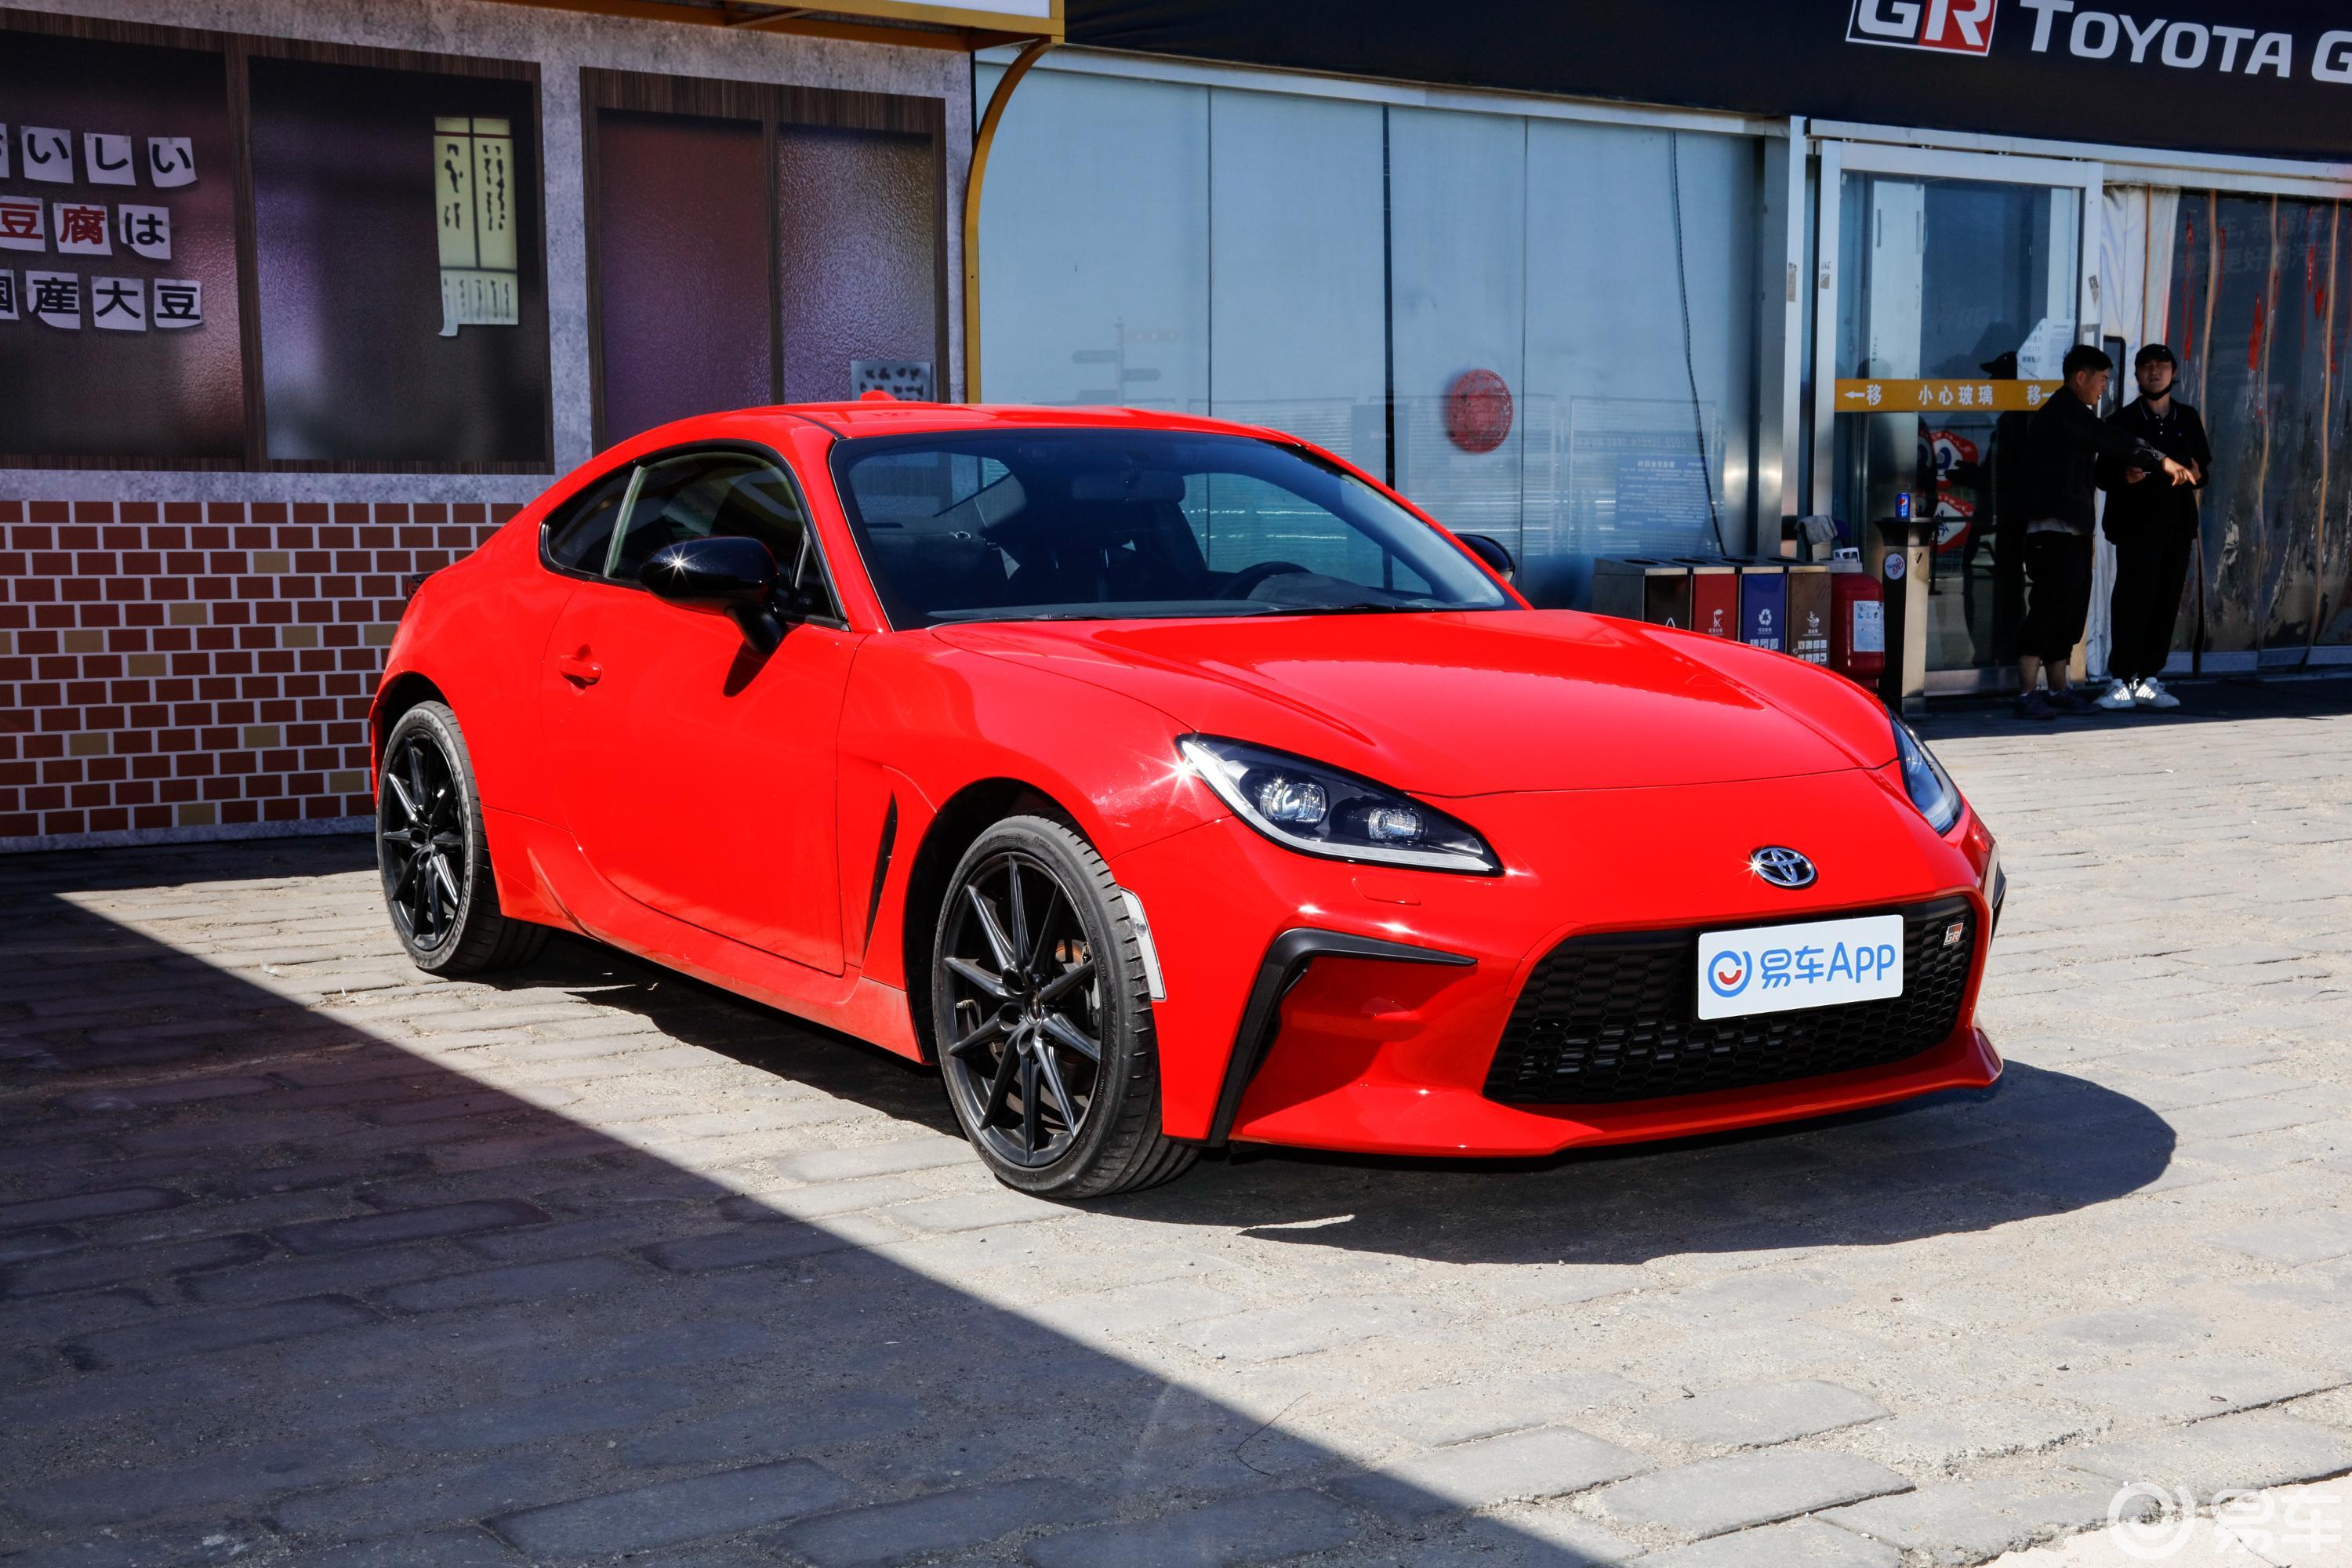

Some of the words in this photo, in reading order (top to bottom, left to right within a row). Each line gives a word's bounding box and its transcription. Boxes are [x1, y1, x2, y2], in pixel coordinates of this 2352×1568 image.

[1857, 0, 1991, 46] GR
[2020, 0, 2292, 78] TOYOTA
[0, 132, 192, 174] いしい
[0, 201, 165, 245] 豆腐は
[1866, 384, 1882, 406] 移
[1918, 384, 1994, 406] 小心玻璃
[2026, 384, 2042, 406] 移
[1759, 942, 1896, 989] 易车App
